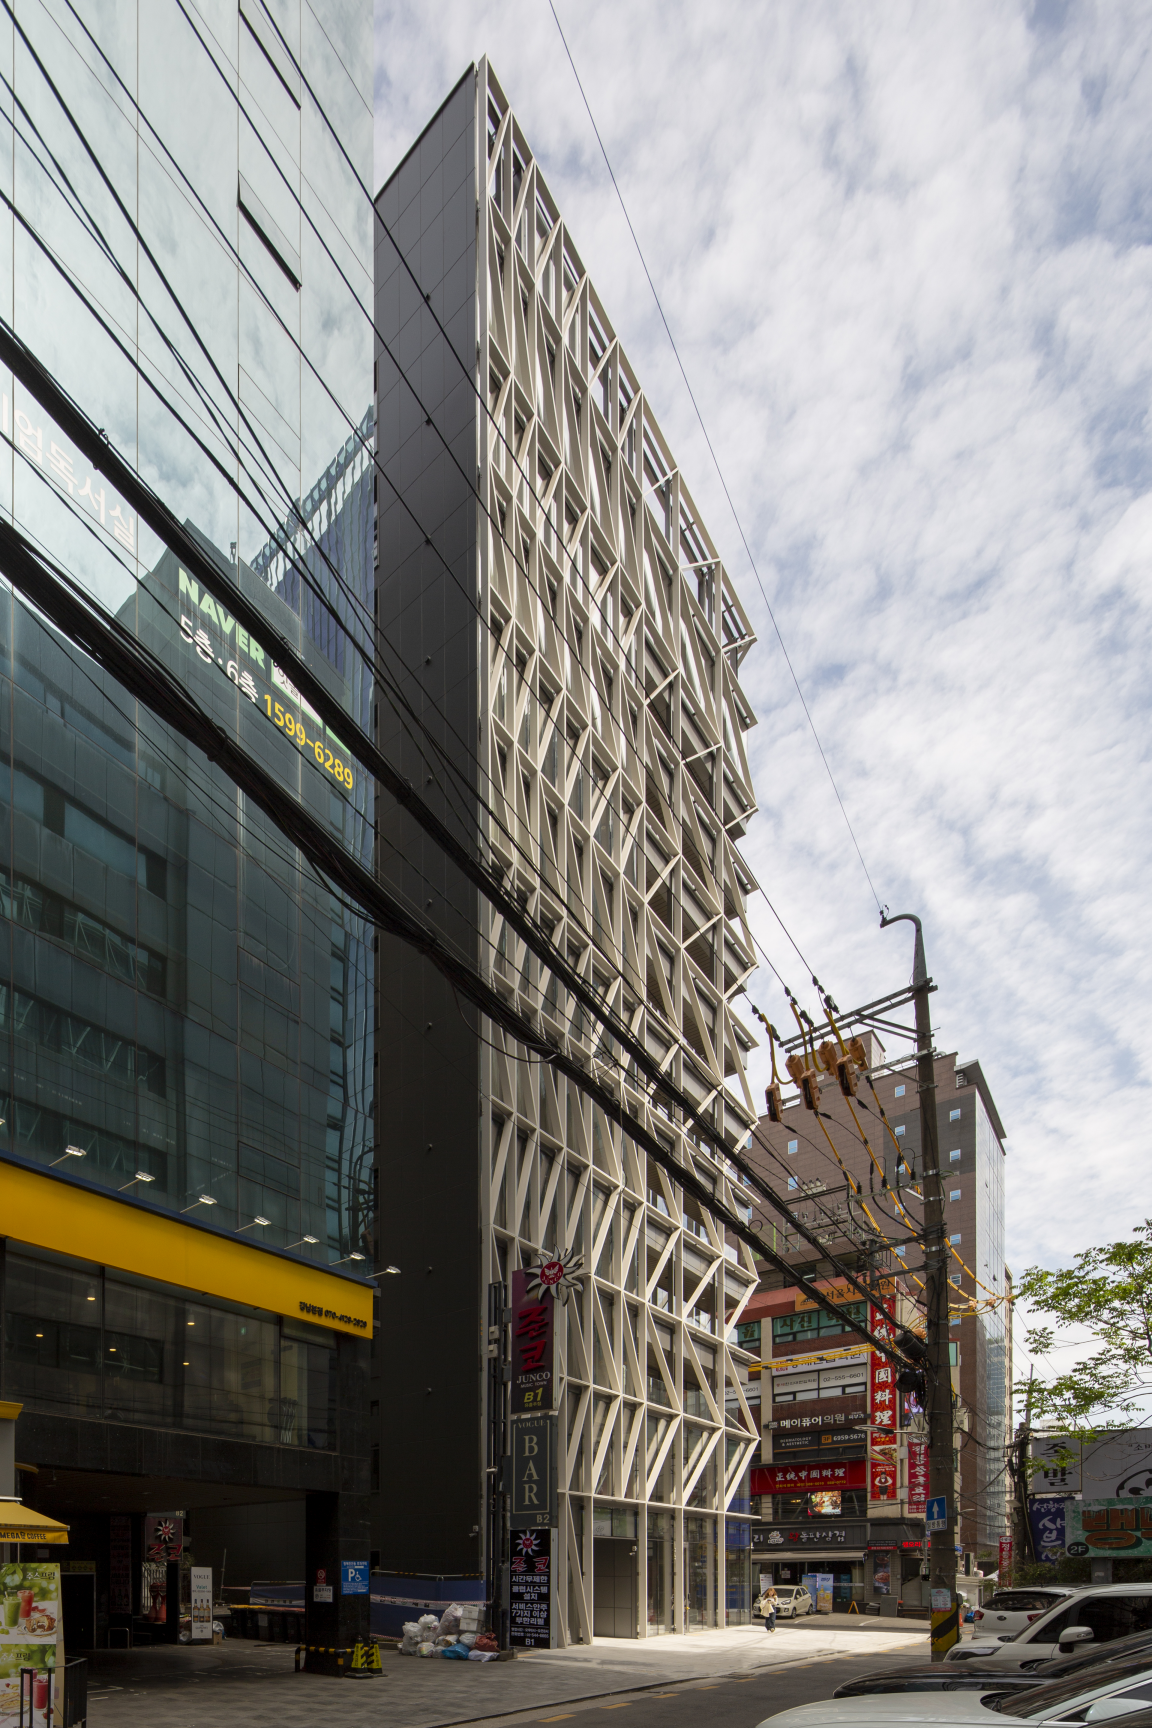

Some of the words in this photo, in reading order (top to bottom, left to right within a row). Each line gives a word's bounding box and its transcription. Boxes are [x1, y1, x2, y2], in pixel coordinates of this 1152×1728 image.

[179, 567, 265, 670] NAVER
[264, 694, 353, 789] 1599-6289
[515, 1306, 549, 1372] 준코
[516, 1371, 550, 1384] JUNCO
[524, 1387, 543, 1403] B1
[518, 1419, 546, 1428] VOGUE
[780, 1415, 822, 1429] 메이퓨어
[823, 1413, 845, 1425] 의원
[833, 1433, 866, 1441] 6959-5676
[522, 1435, 540, 1505] BAR
[537, 1514, 550, 1524] B2
[0, 1532, 21, 1540] MEGA
[1070, 1545, 1086, 1554] 2F
[26, 1572, 55, 1581] 주스프링
[511, 1575, 548, 1583] 시간무제한
[511, 1602, 548, 1611] 서비스안주
[525, 1638, 535, 1646] B1
[1, 1652, 31, 1662] 주스프링
